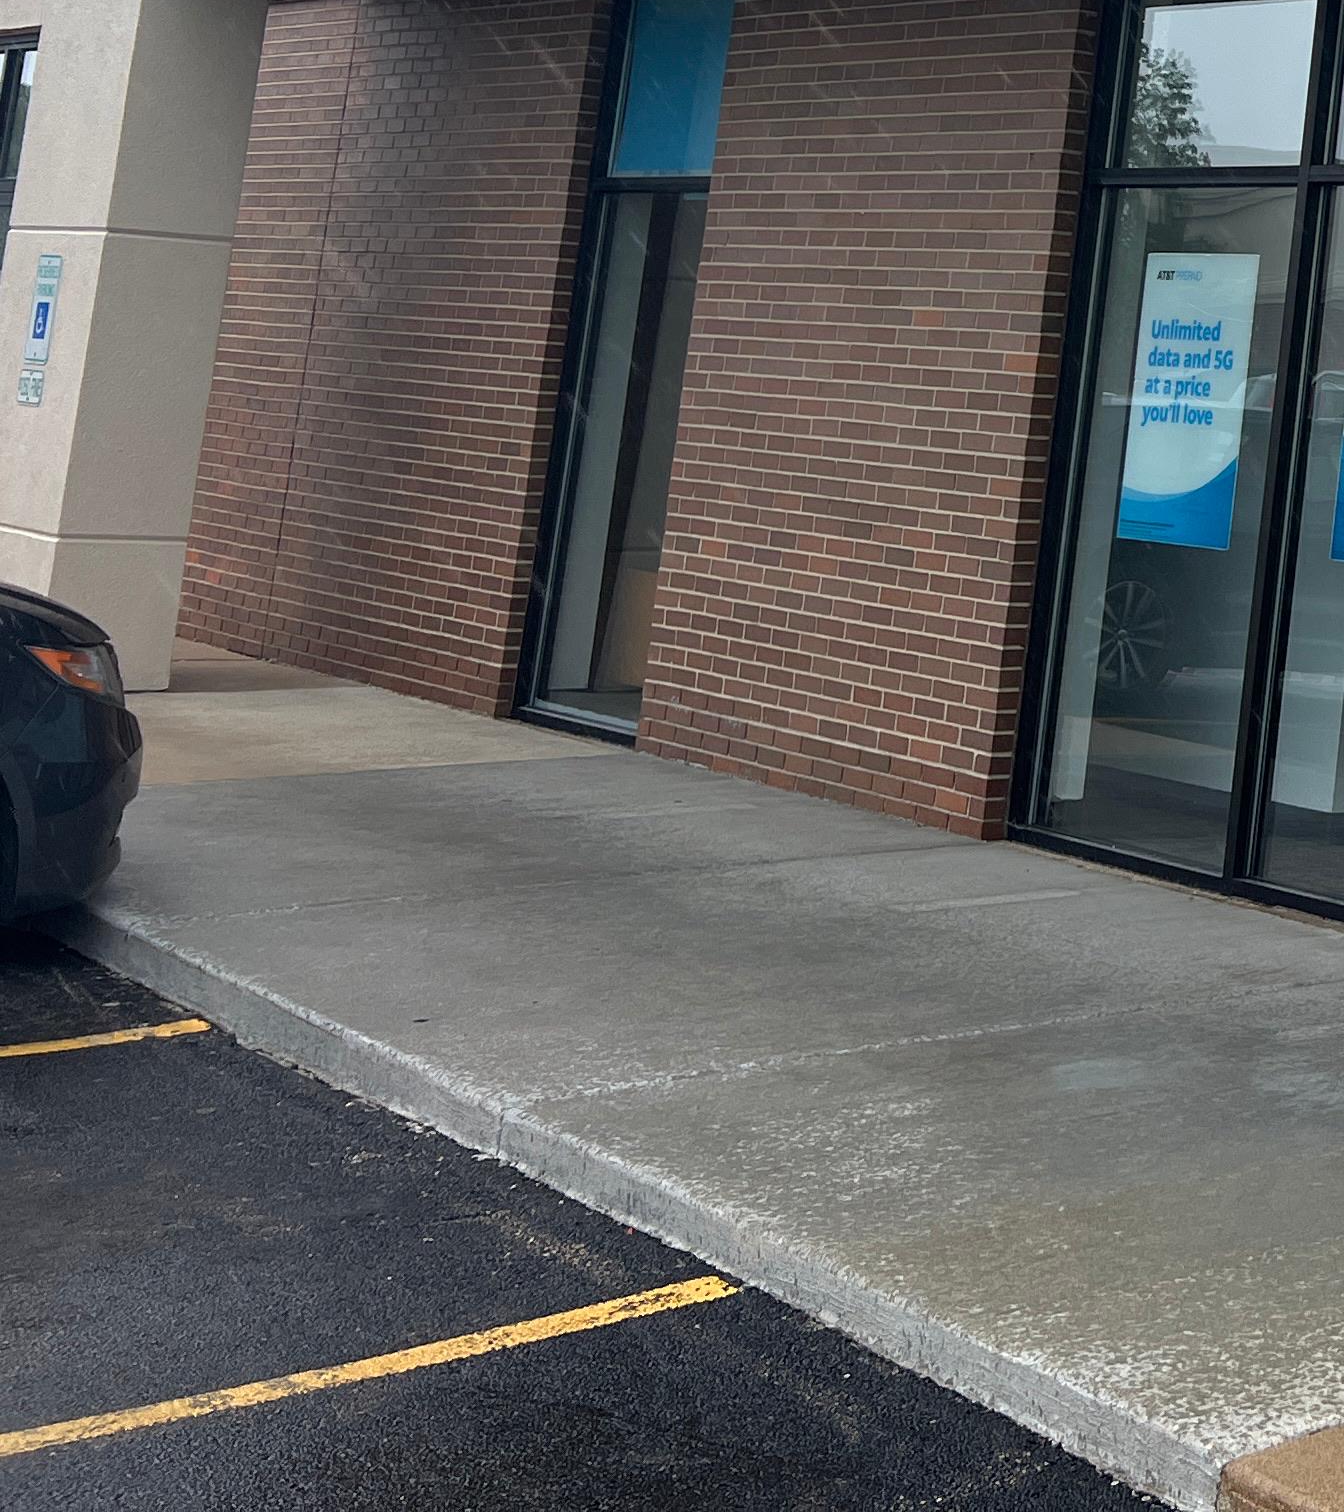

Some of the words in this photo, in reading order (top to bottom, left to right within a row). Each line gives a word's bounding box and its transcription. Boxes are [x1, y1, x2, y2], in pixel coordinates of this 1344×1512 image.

[1151, 319, 1222, 342] Unlimited
[1148, 345, 1180, 368] data
[1183, 349, 1211, 370] and
[1214, 350, 1234, 371] 5G
[1144, 377, 1160, 395] at
[1163, 380, 1171, 395] a
[1174, 376, 1211, 400] price
[1140, 403, 1181, 426] you'll
[1183, 404, 1213, 426] love
